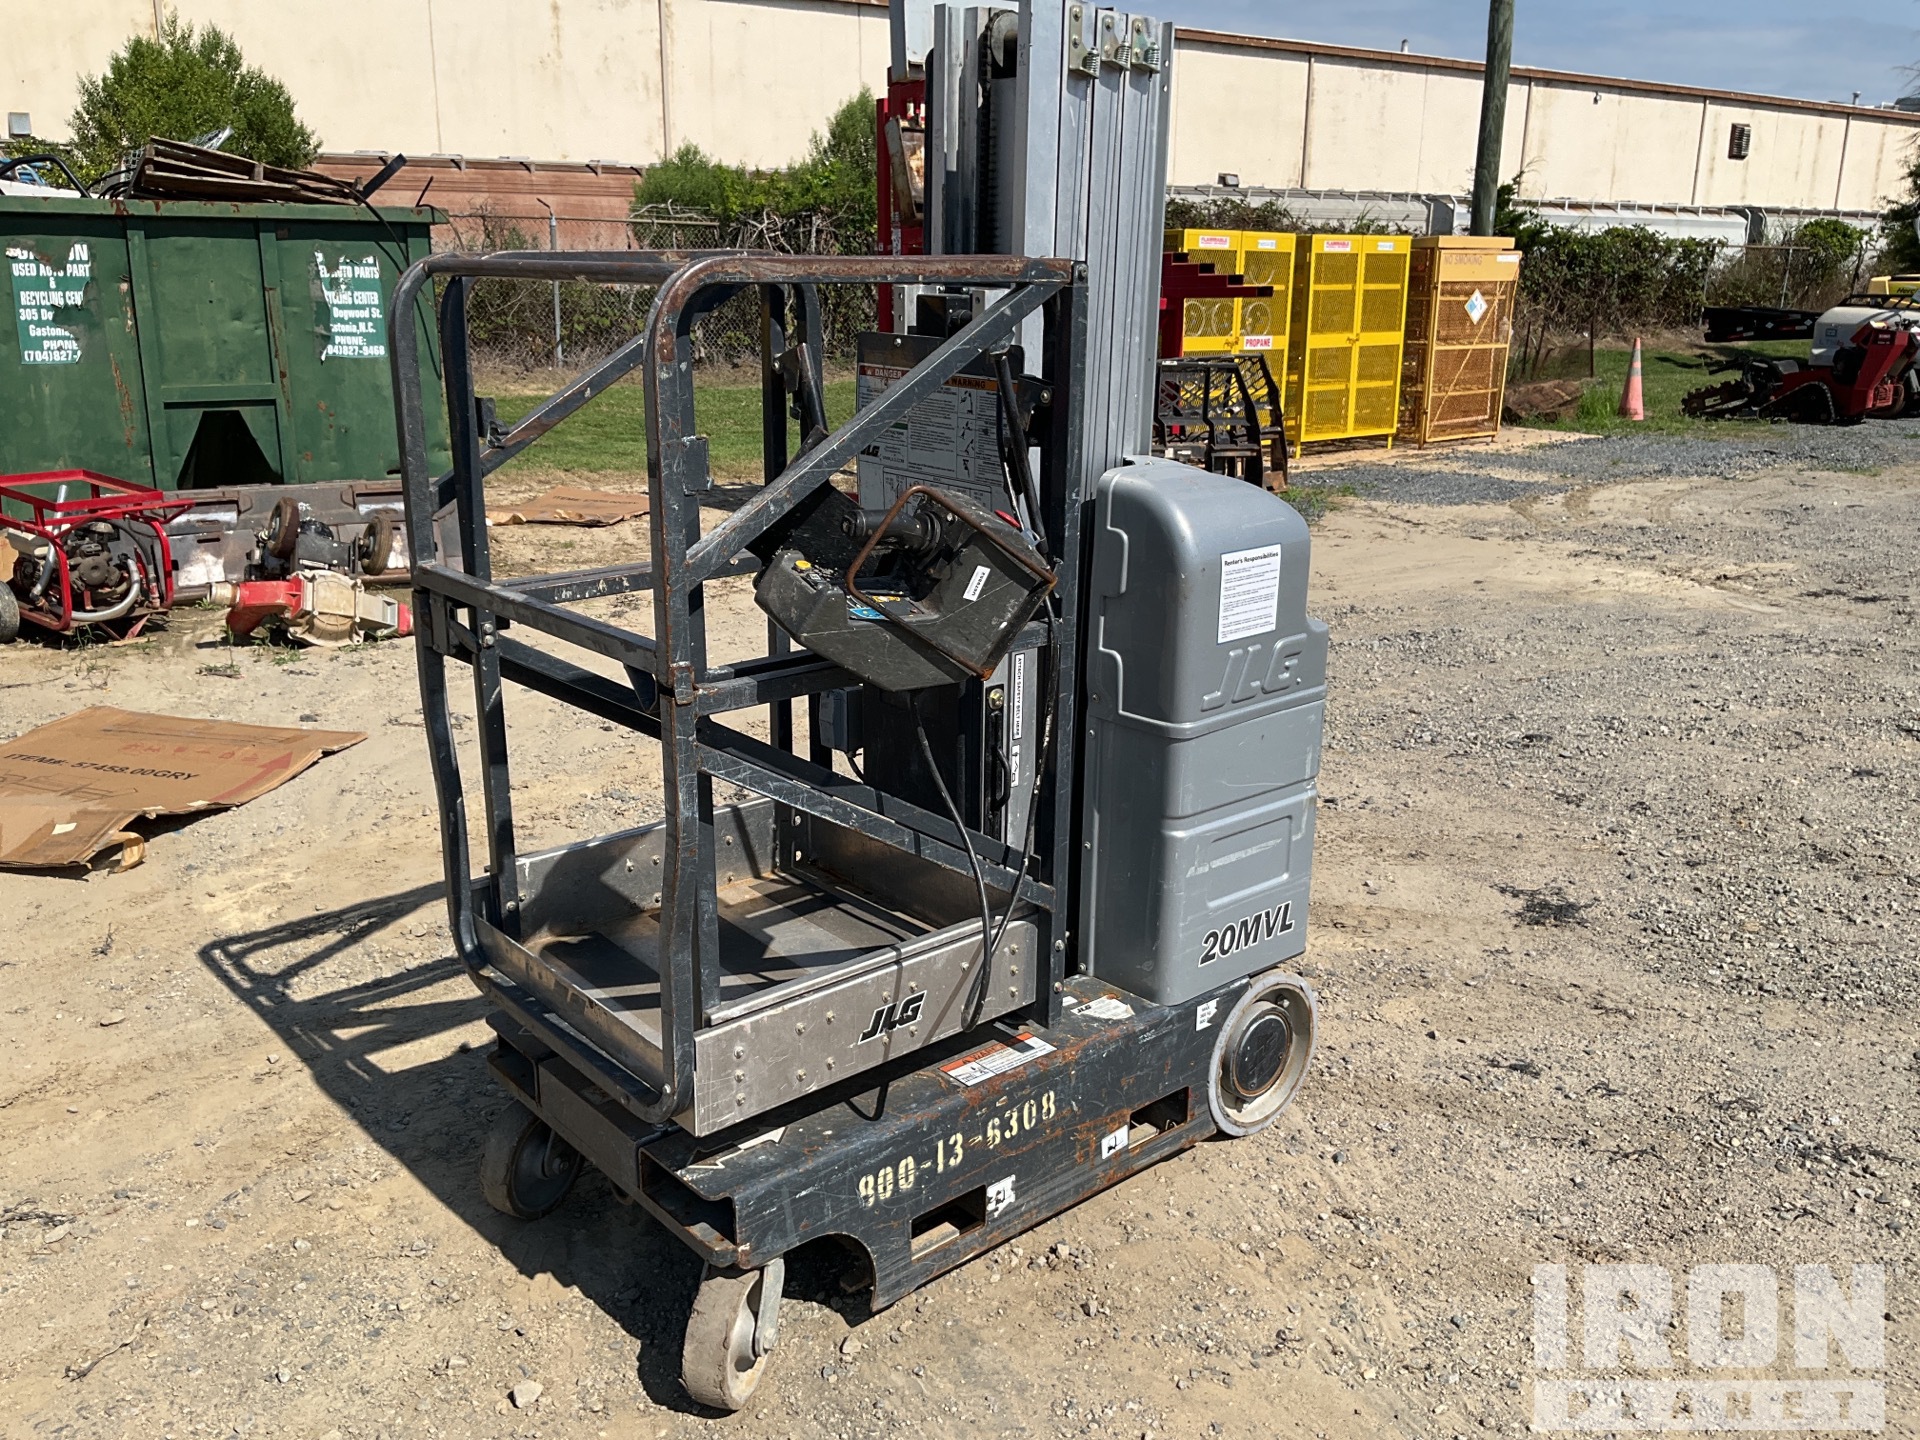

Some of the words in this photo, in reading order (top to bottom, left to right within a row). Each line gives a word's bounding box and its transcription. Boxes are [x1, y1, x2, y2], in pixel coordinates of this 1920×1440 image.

[12, 263, 37, 277] USED
[39, 264, 65, 277] AU
[354, 265, 380, 279] PARTS
[49, 277, 56, 289] &
[20, 291, 64, 306] RECYCLING
[353, 291, 379, 305] CENTER
[19, 308, 38, 321] 305
[333, 306, 370, 320] Dogwood
[370, 307, 383, 318] St.
[334, 335, 367, 346] PHONE:
[1245, 338, 1271, 348] PROPANE
[874, 368, 902, 379] DANGER
[950, 379, 986, 389] WARNING
[1224, 558, 1243, 567] Renter's
[1244, 552, 1279, 563] Responsibilities
[1201, 633, 1308, 712] JLG
[3, 753, 69, 767] ITEM#:
[71, 760, 201, 782] 57458.00GRY
[1198, 900, 1296, 968] 20MVL
[858, 989, 927, 1046] JLG
[859, 1089, 1056, 1208] 800-13-6308
